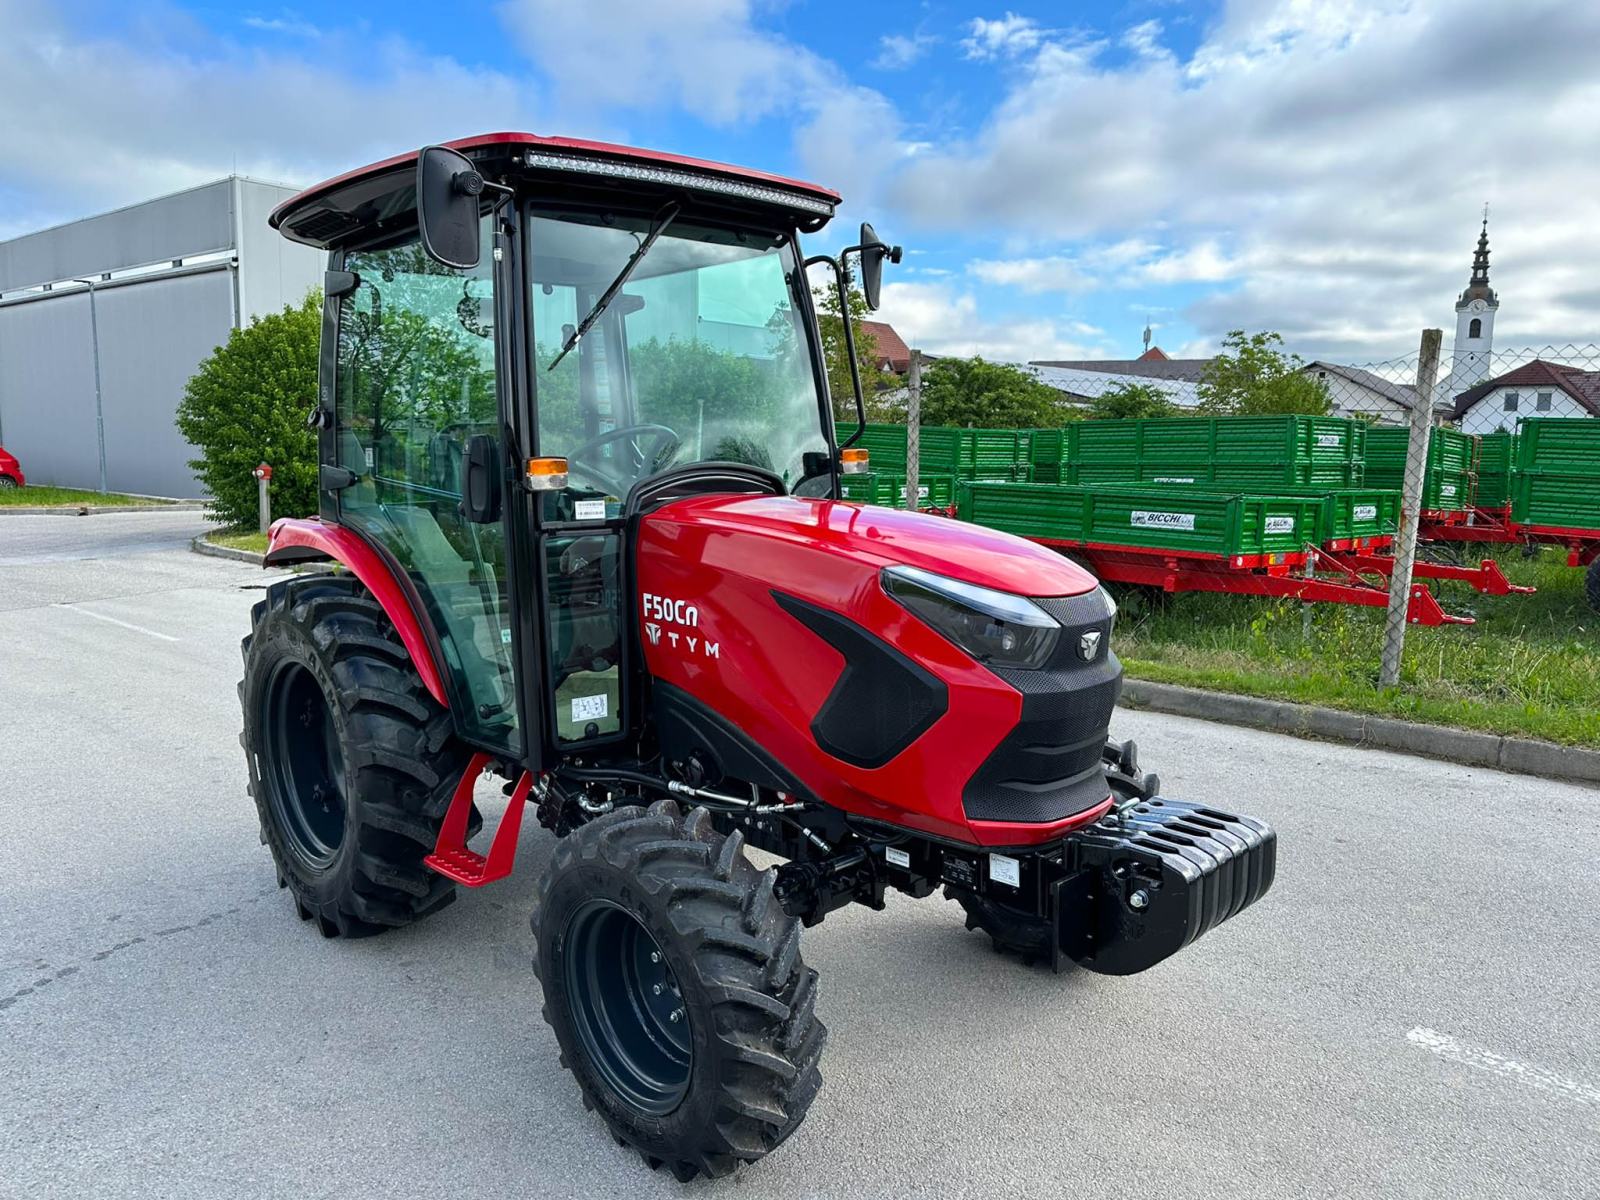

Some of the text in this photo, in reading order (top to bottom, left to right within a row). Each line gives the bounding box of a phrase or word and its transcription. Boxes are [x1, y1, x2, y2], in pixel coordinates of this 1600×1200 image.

[1147, 513, 1182, 523] BICCHI
[642, 592, 698, 627] F50Cn
[667, 631, 720, 659] TYM
